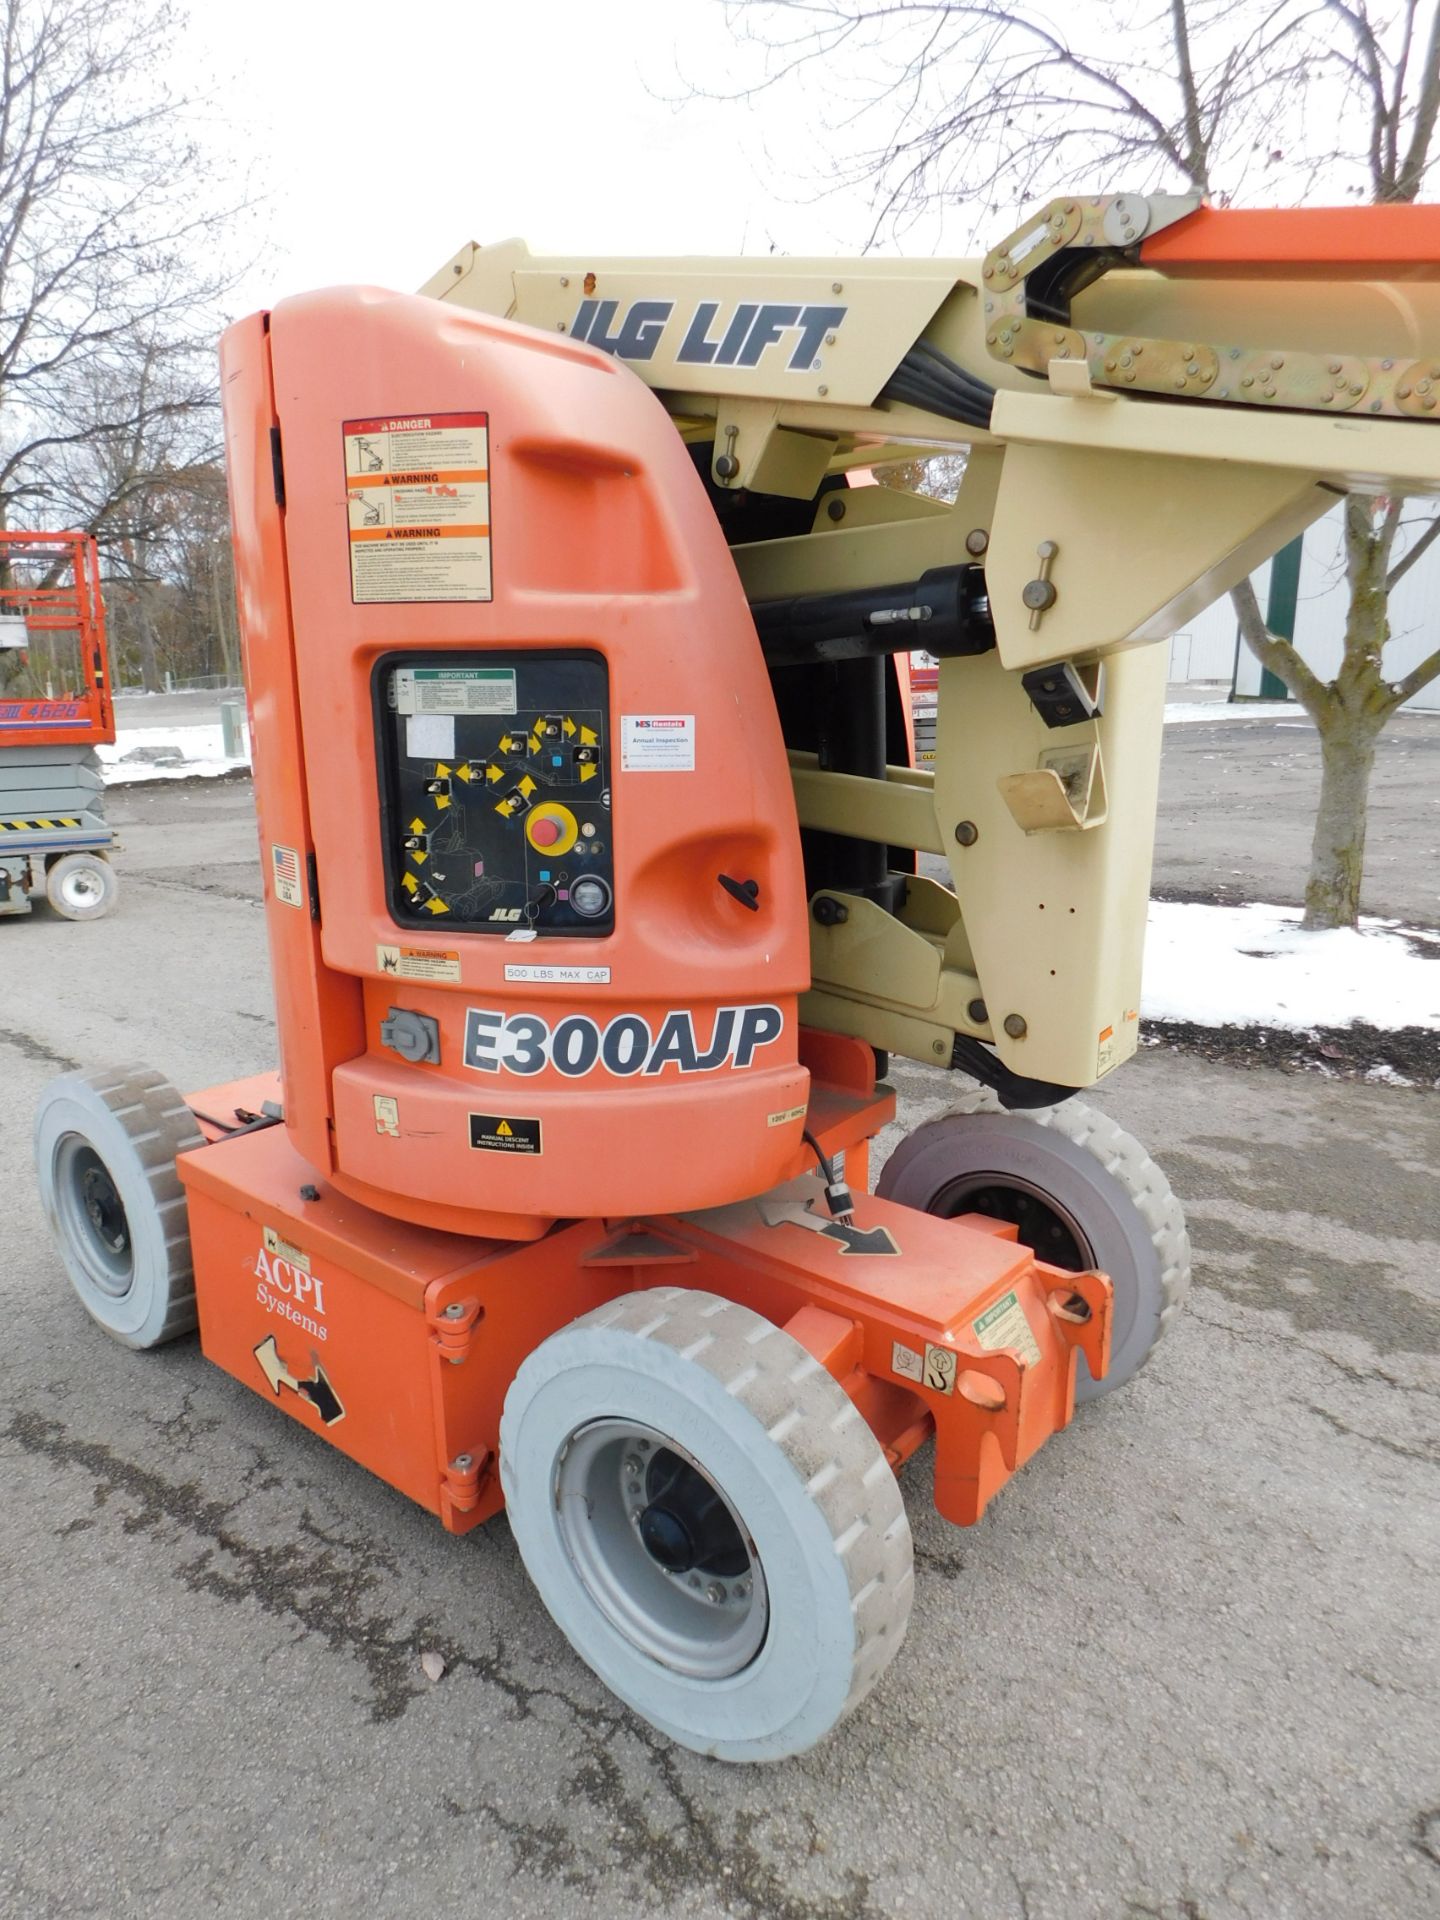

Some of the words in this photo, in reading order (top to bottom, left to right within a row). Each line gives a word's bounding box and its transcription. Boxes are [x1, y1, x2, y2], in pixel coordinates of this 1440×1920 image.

[674, 302, 848, 372] LIFT
[389, 418, 432, 431] DANGER
[391, 473, 439, 484] WARNING
[394, 528, 441, 538] WARNING
[438, 672, 479, 680] IMPORTANT
[656, 737, 689, 745] Inspection
[488, 907, 522, 922] JLG
[416, 951, 447, 960] WARNING
[507, 969, 528, 978] 500
[533, 970, 554, 979] LBS
[560, 971, 580, 979] MAX
[587, 971, 608, 980] CAP
[463, 1004, 784, 1078] E300AJP
[481, 1134, 504, 1142] MANUAL
[476, 1140, 515, 1148] INSTRUCTIONS
[254, 1248, 326, 1315] ACPI
[256, 1282, 328, 1342] Systems
[985, 1296, 1013, 1326] IMPORTANT
